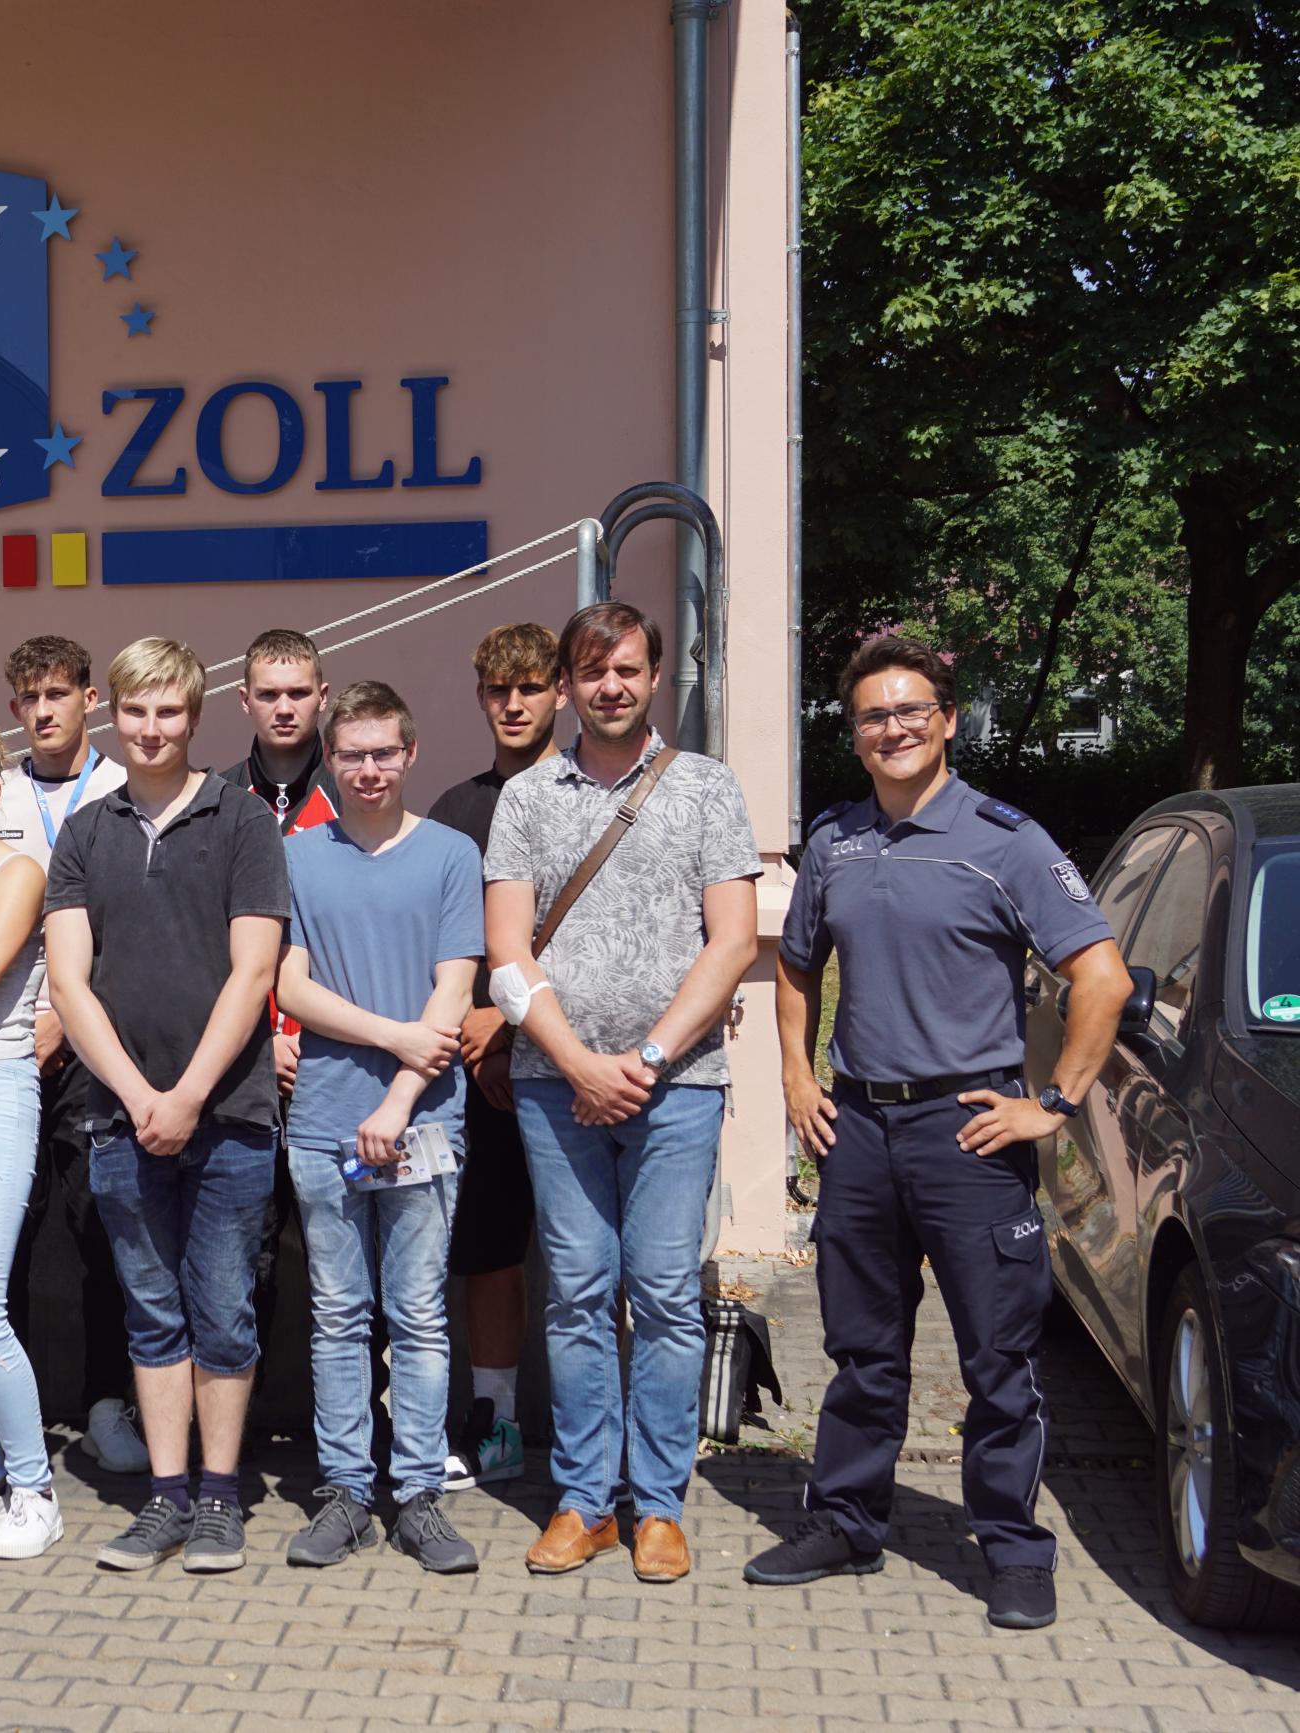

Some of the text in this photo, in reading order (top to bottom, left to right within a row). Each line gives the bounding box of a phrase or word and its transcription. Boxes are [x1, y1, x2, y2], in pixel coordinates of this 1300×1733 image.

[102, 375, 482, 496] ZOLL
[832, 839, 863, 855] ZOLL
[1280, 996, 1292, 1007] 4
[1012, 1218, 1040, 1239] ZOLL
